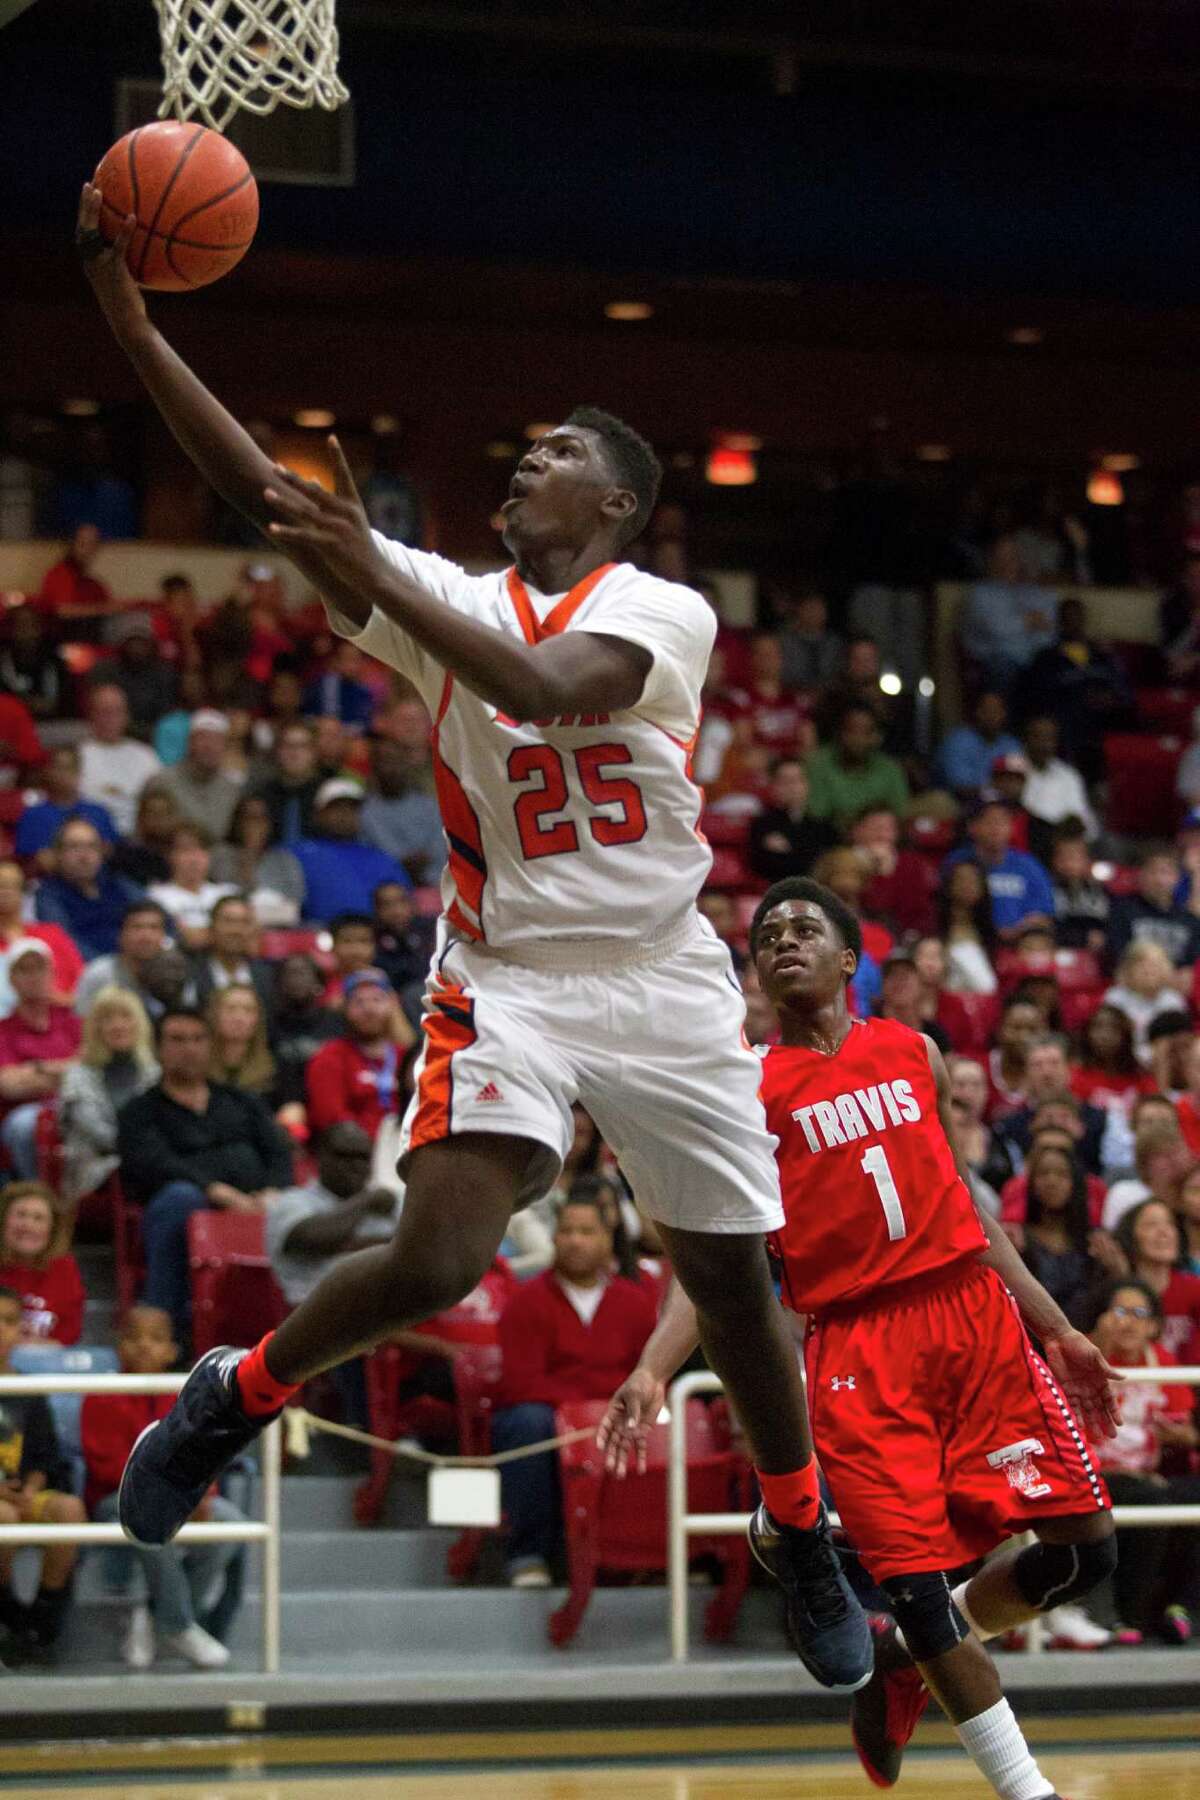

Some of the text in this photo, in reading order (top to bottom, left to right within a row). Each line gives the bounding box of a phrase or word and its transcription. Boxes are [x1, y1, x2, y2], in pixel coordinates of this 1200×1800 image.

[507, 742, 648, 861] 25
[792, 1079, 921, 1154] TRAVIS
[861, 1144, 907, 1241] 1
